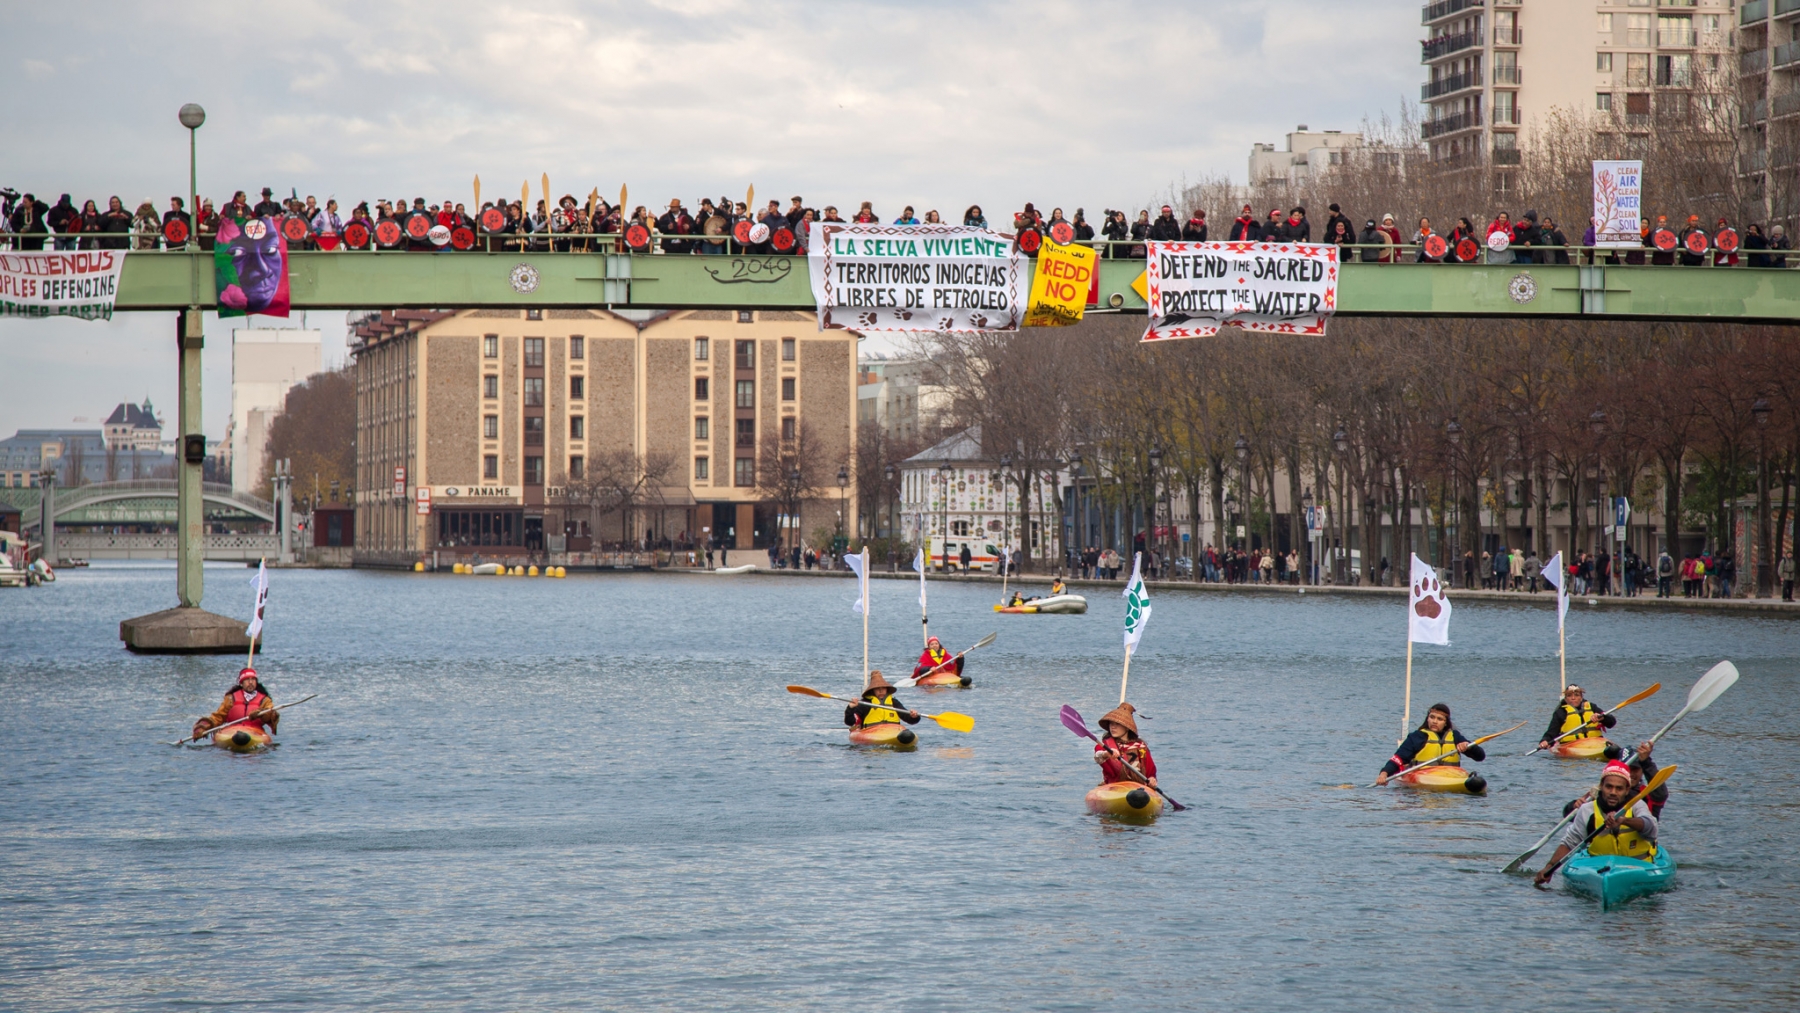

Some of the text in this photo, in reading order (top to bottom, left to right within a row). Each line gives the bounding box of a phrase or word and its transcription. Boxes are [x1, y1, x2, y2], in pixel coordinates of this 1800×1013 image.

[1617, 167, 1639, 175] CLEAN
[1619, 176, 1637, 187] AIR
[1618, 188, 1639, 196] CLEAN
[1616, 196, 1640, 208] WATER
[1618, 210, 1637, 218] CLEAN
[1619, 219, 1638, 231] SOIL
[834, 237, 1008, 258] LA SELVA VIVIENTE
[836, 262, 931, 284] TERRITORIOS
[1043, 257, 1090, 282] REDD
[1161, 253, 1324, 282] DEFEND THE SACRED
[42, 275, 115, 300] DEFENDING
[1045, 279, 1076, 302] NO
[836, 287, 1008, 310] LIBRES DE PETROLEO
[1162, 289, 1321, 316] PROTECT THE WATER
[468, 487, 510, 496] PANAME
[1618, 504, 1624, 521] P
